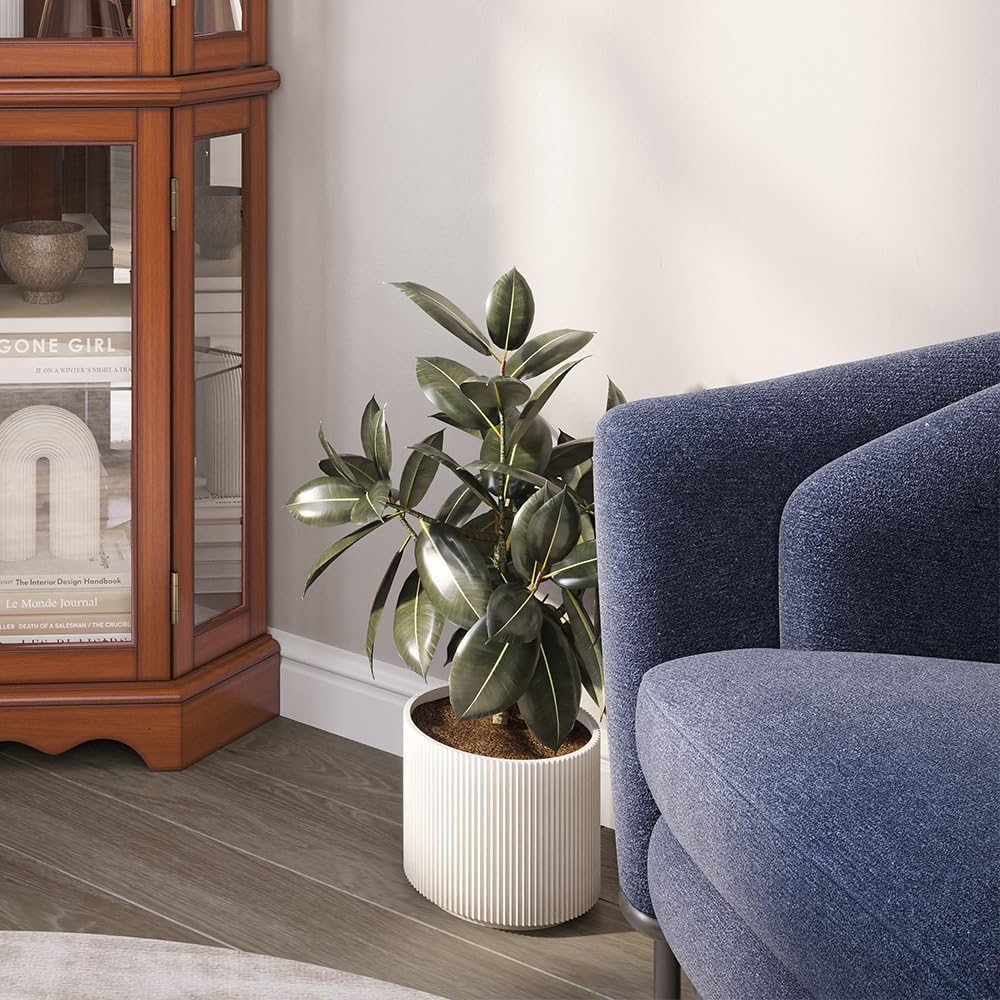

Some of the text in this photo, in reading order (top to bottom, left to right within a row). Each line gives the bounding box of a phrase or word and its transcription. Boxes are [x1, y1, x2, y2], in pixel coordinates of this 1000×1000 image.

[68, 337, 116, 353] GIRL
[57, 578, 82, 586] Design
[84, 577, 121, 585] Handbook
[6, 597, 98, 609] Le Monde Journal
